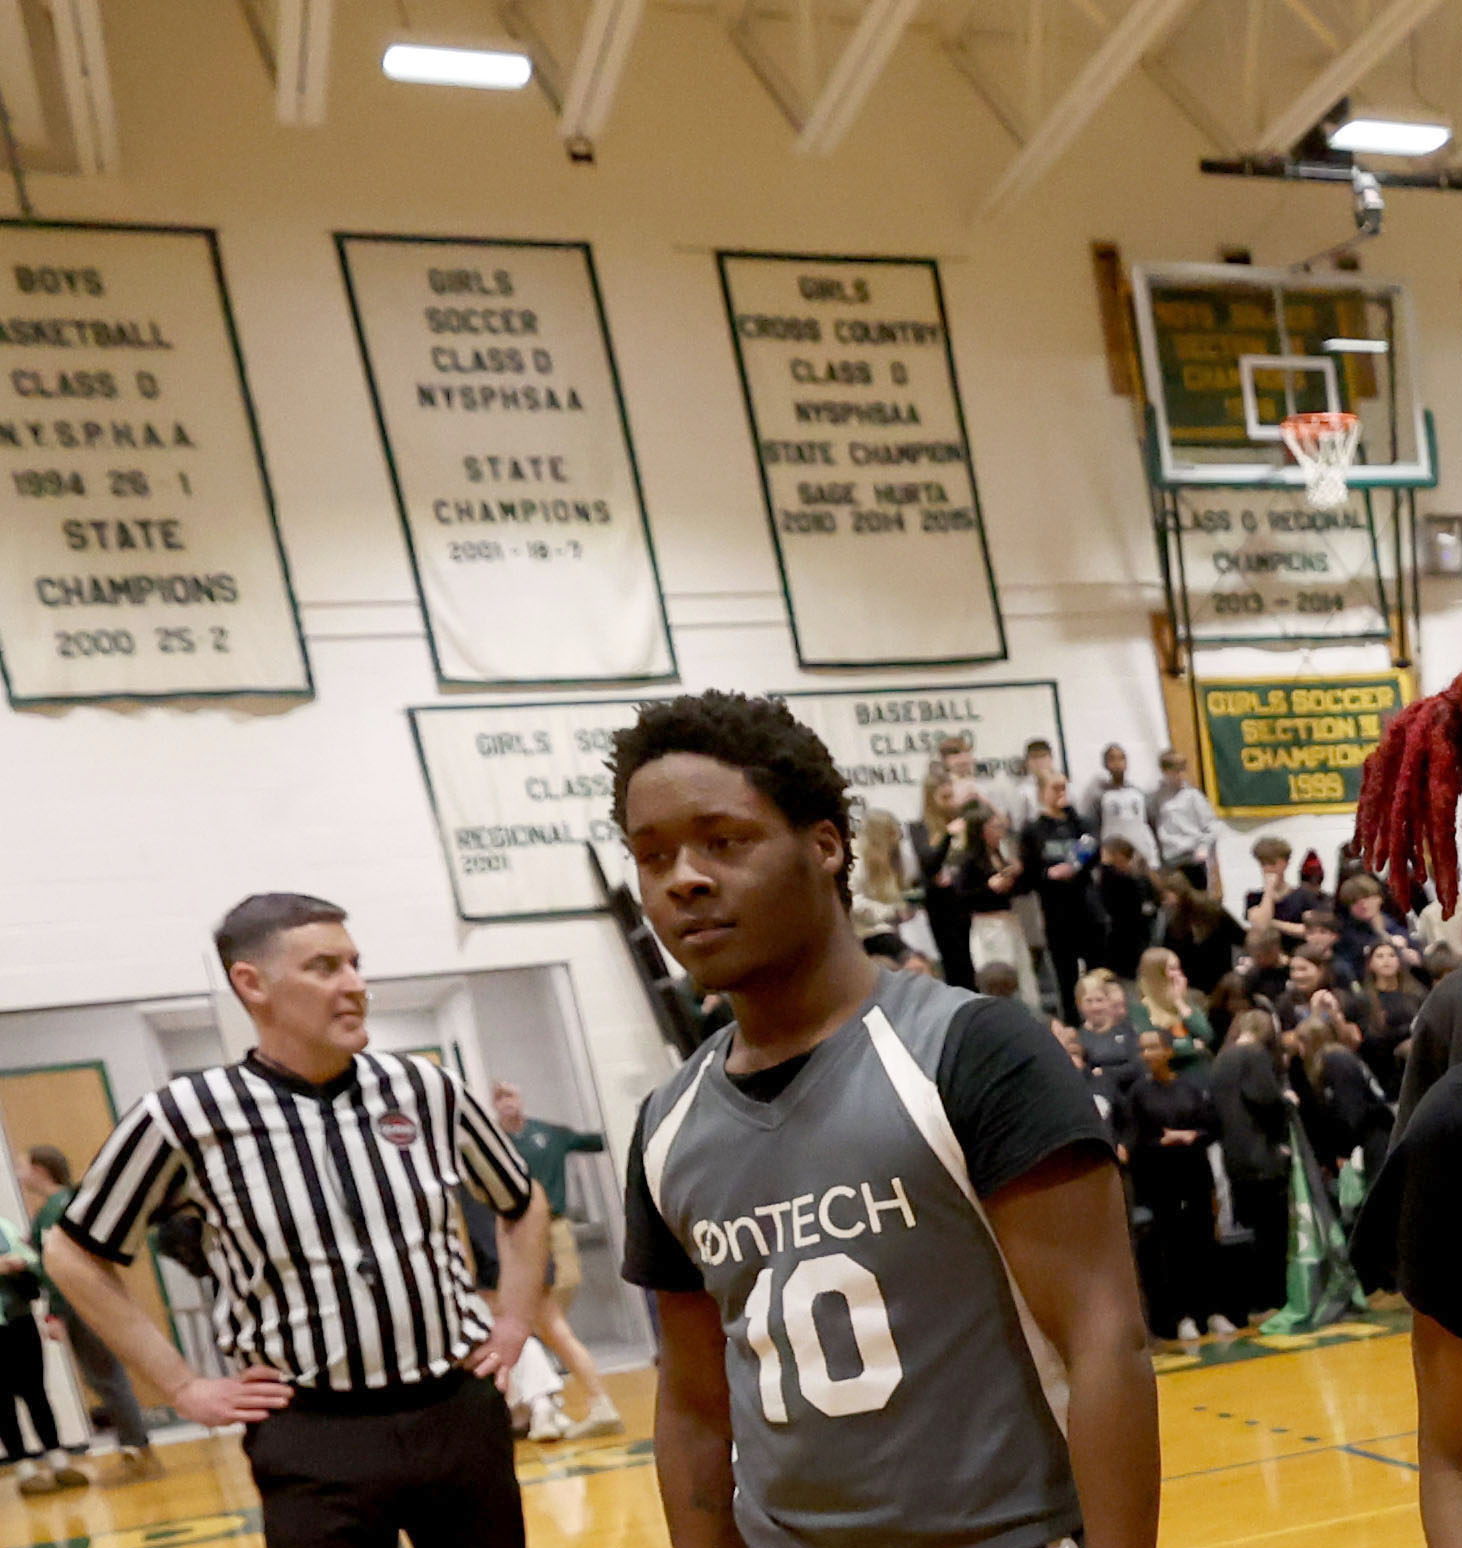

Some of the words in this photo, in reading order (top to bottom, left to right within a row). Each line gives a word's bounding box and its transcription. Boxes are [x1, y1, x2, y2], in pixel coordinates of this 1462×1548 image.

[15, 266, 104, 296] BOYS
[428, 268, 515, 298] GIRLS
[424, 307, 539, 336] SOCCER
[431, 346, 525, 374] CLASS
[790, 358, 873, 386] CLASS
[11, 369, 118, 399] CLASS
[416, 383, 585, 412] NYSPHSAA
[463, 455, 569, 484] STATE
[433, 498, 612, 526] CHAMPIONS
[63, 519, 186, 551] STATE
[36, 574, 238, 607] CHAMPIONS
[854, 698, 981, 726] BASEBALL
[1206, 688, 1289, 717] GIRLS
[1290, 685, 1396, 714] SOCCER
[1240, 716, 1355, 744] SECTION
[1240, 742, 1384, 772] CHAMPION
[744, 1253, 904, 1424] 10
